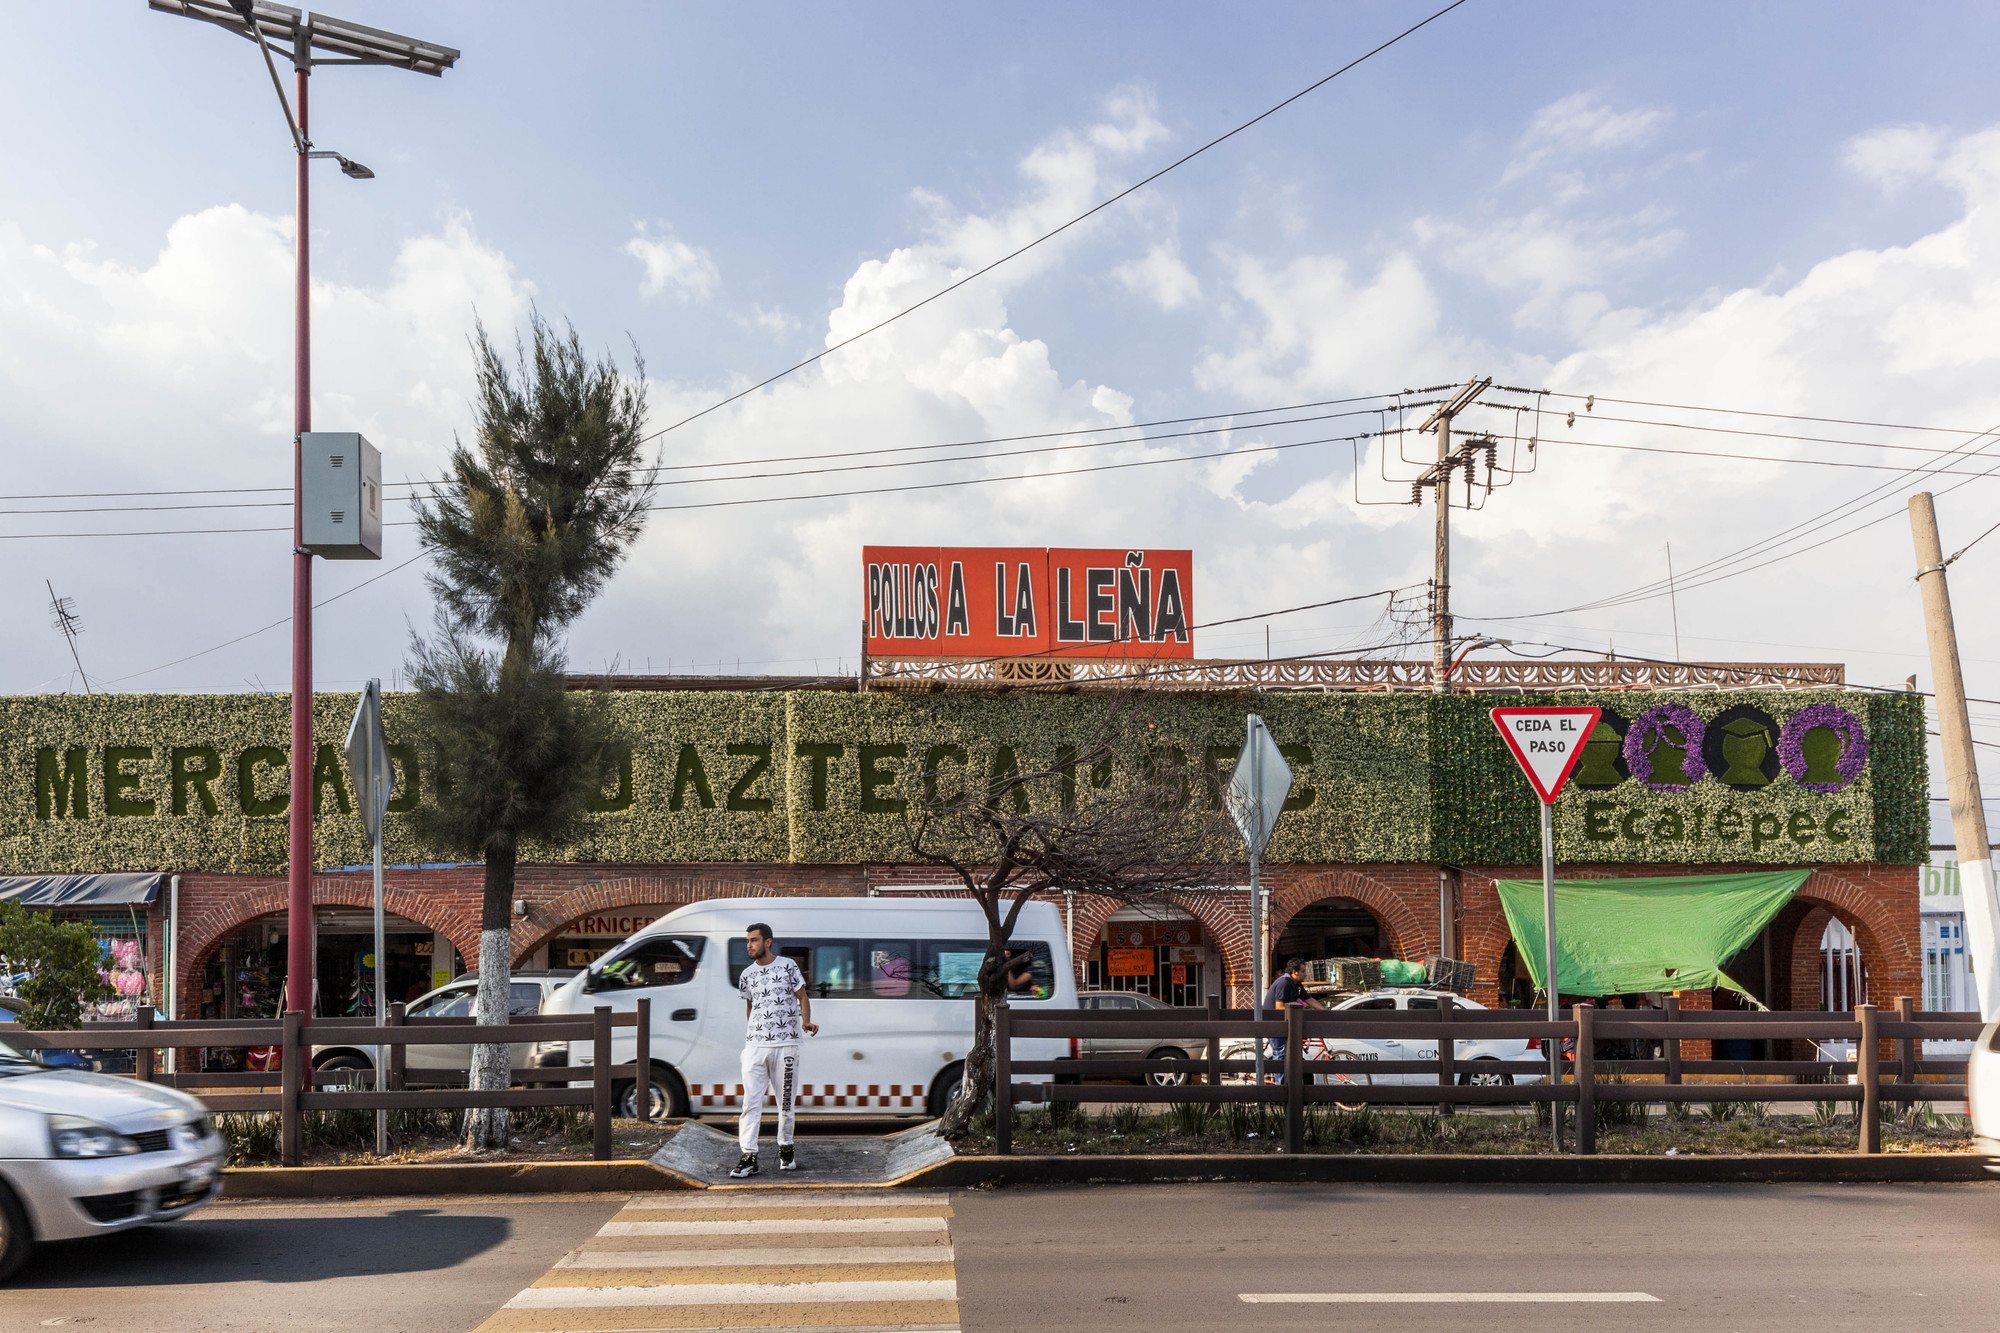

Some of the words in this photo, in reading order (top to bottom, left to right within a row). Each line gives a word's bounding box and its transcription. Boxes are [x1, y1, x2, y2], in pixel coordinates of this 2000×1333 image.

[868, 562, 939, 640] POLLOS
[945, 561, 970, 636] A
[995, 561, 1037, 637] LA
[1056, 551, 1190, 643] LEÑA
[1515, 719, 1552, 732] CEDA
[1560, 719, 1577, 731] EL
[1529, 740, 1566, 753] PASO
[37, 744, 482, 819] MERCAD
